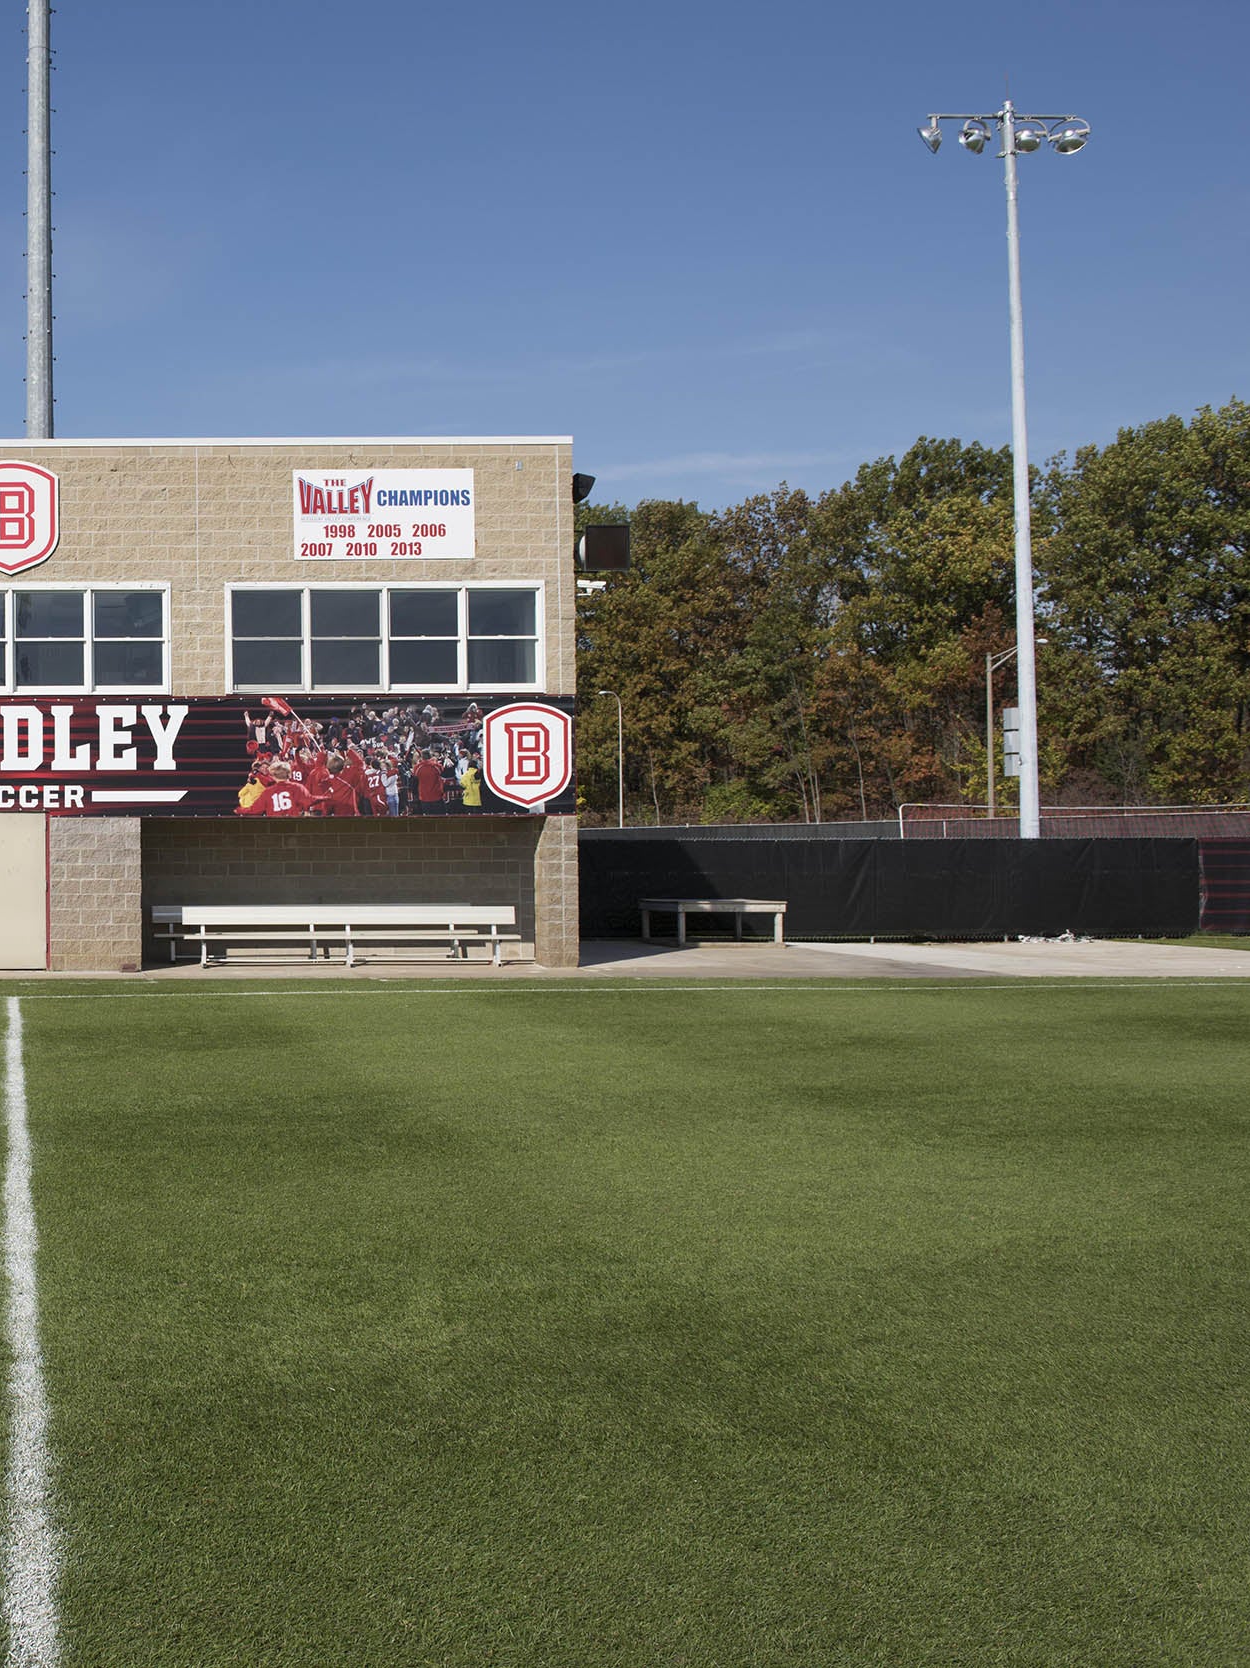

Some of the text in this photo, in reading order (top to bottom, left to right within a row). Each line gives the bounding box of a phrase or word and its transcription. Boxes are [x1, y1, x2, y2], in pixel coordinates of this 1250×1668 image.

[323, 479, 347, 487] THE
[298, 476, 471, 515] VALLEY CHAMPIONS
[323, 523, 447, 539] 1998 2005 2006
[301, 541, 422, 557] 2007 2010 2013
[504, 723, 550, 785] B
[293, 771, 302, 781] 19
[368, 775, 380, 788] 27
[271, 791, 292, 812] 16
